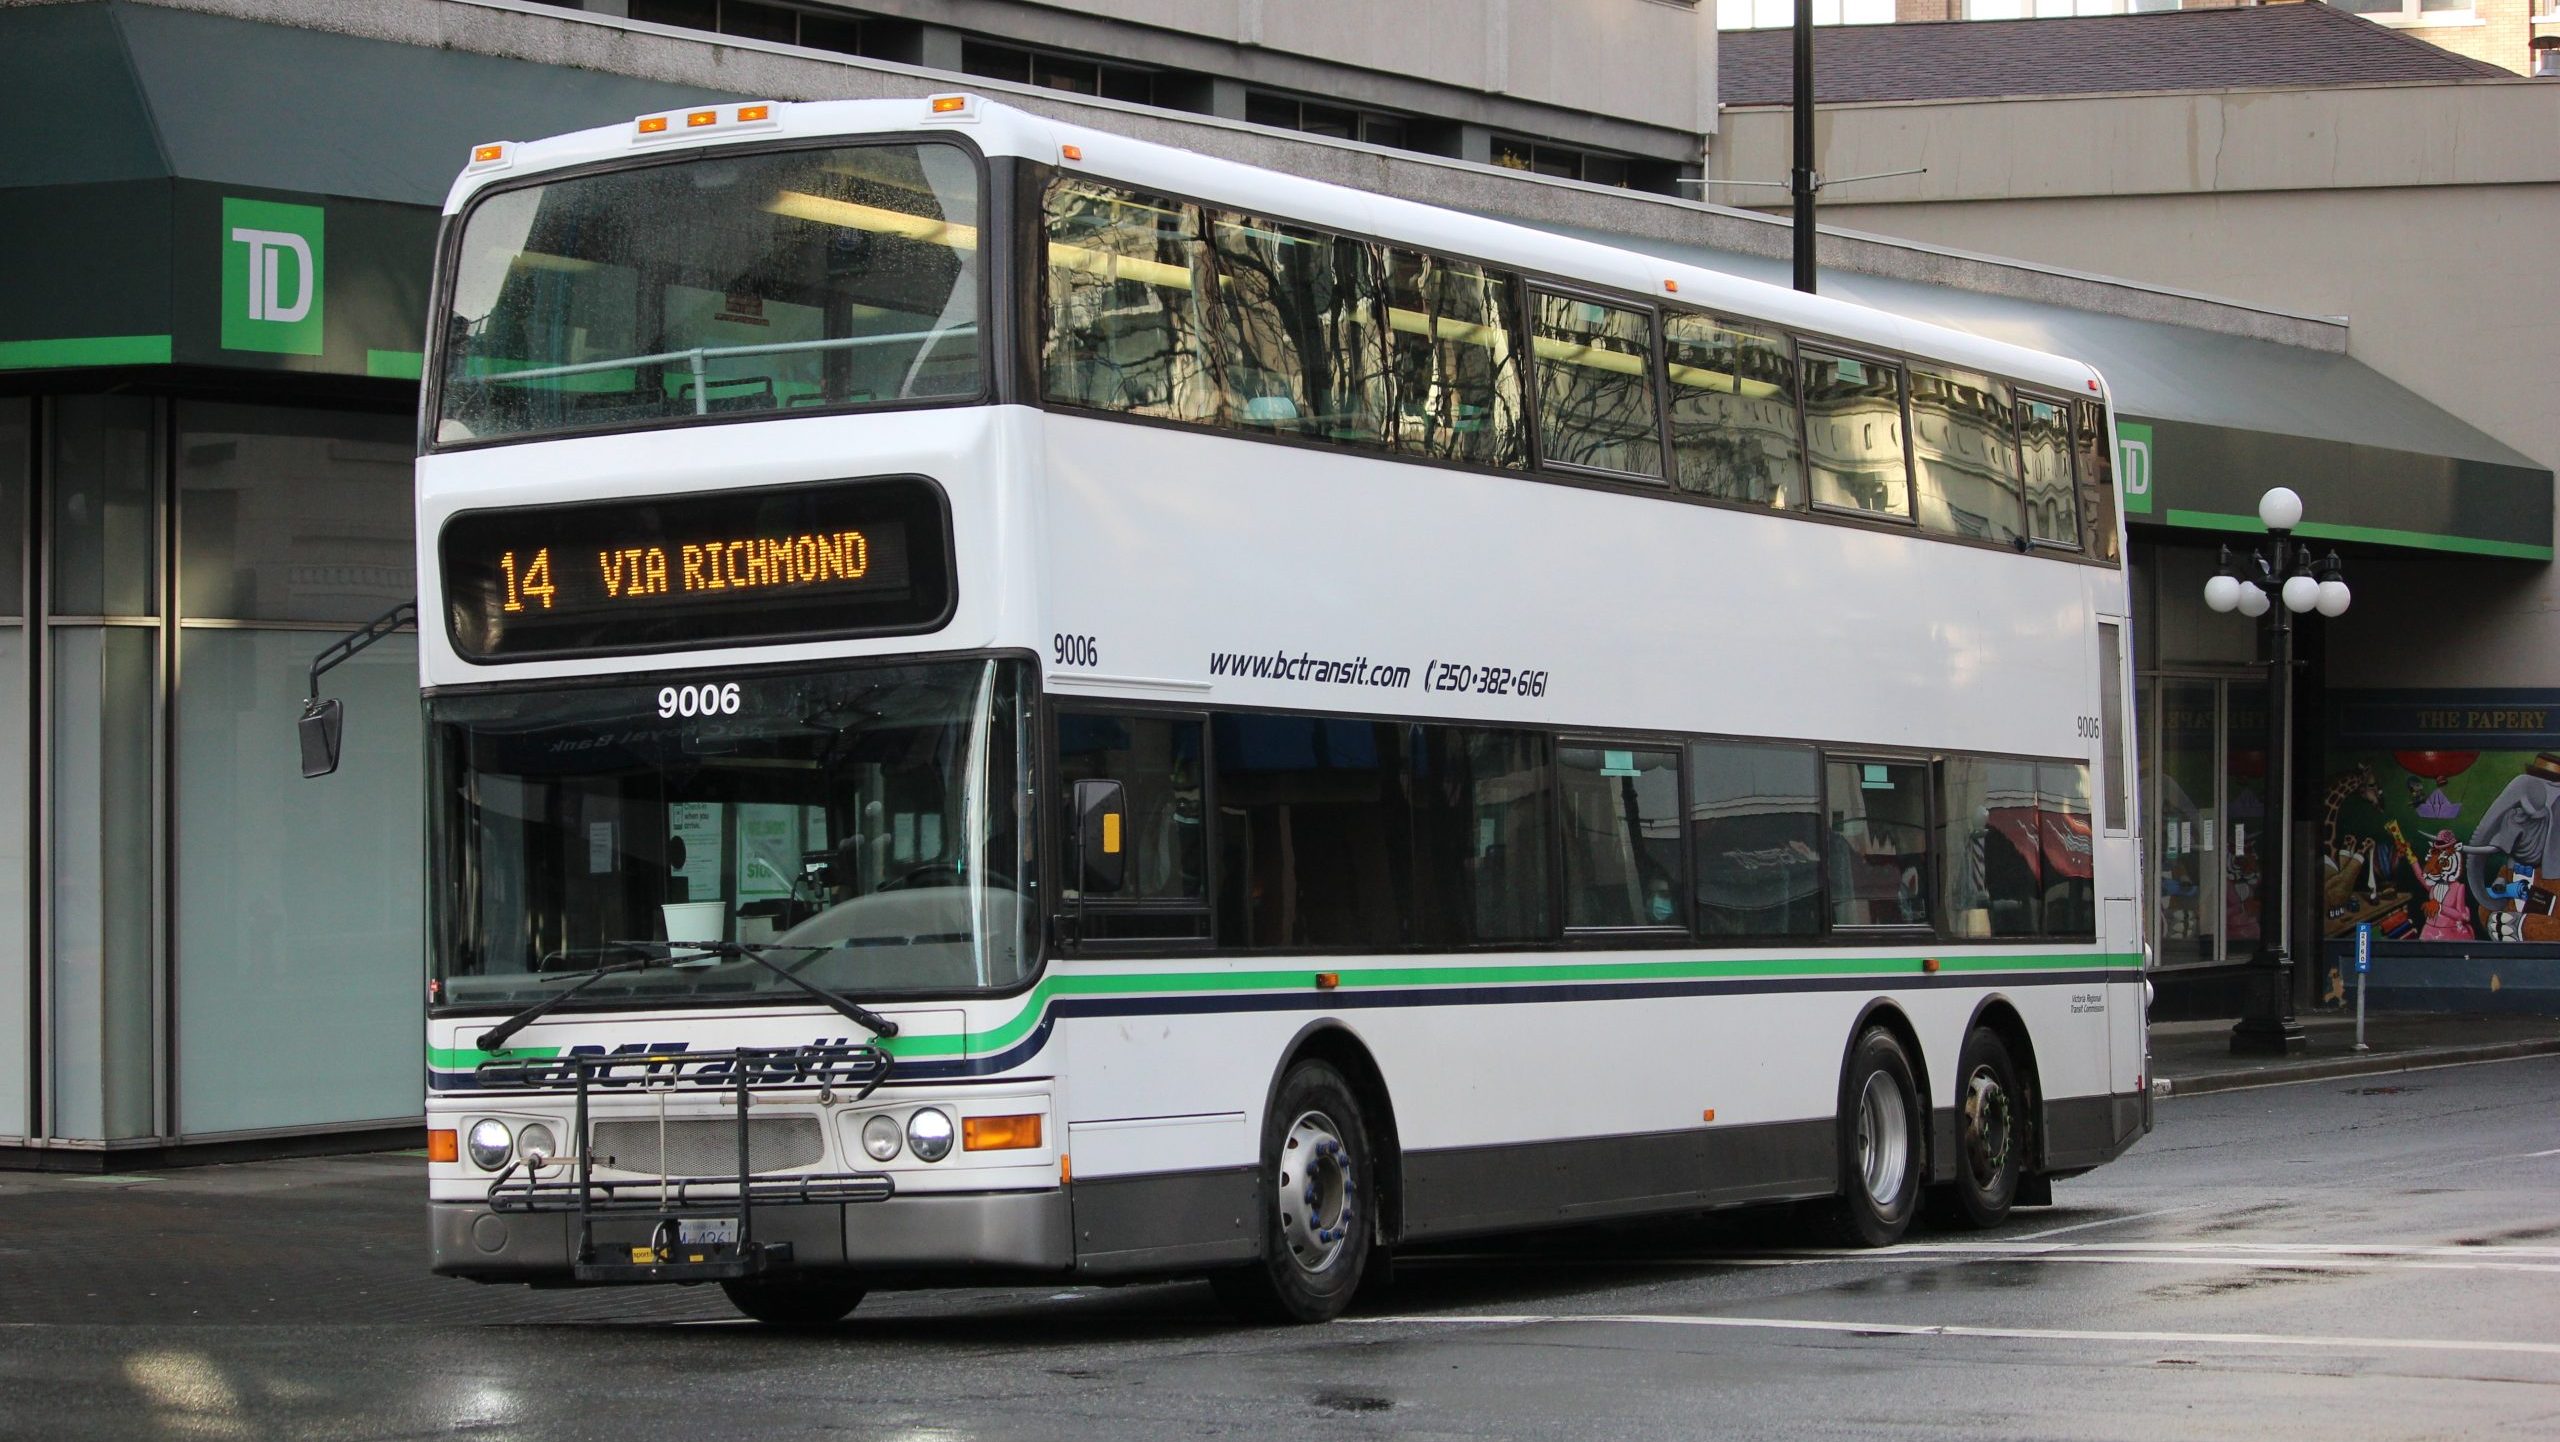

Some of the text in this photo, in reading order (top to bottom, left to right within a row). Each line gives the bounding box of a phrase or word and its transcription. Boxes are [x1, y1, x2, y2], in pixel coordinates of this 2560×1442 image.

[232, 227, 314, 323] TD
[2119, 439, 2149, 495] TD
[501, 531, 868, 612] 14 VIA RICHMOND
[1053, 633, 1098, 667] 9006
[1209, 650, 1411, 688] www.bctransit.com
[657, 683, 741, 719] 9006
[2077, 715, 2100, 739] 9006
[2417, 711, 2547, 729] THE PAPERY
